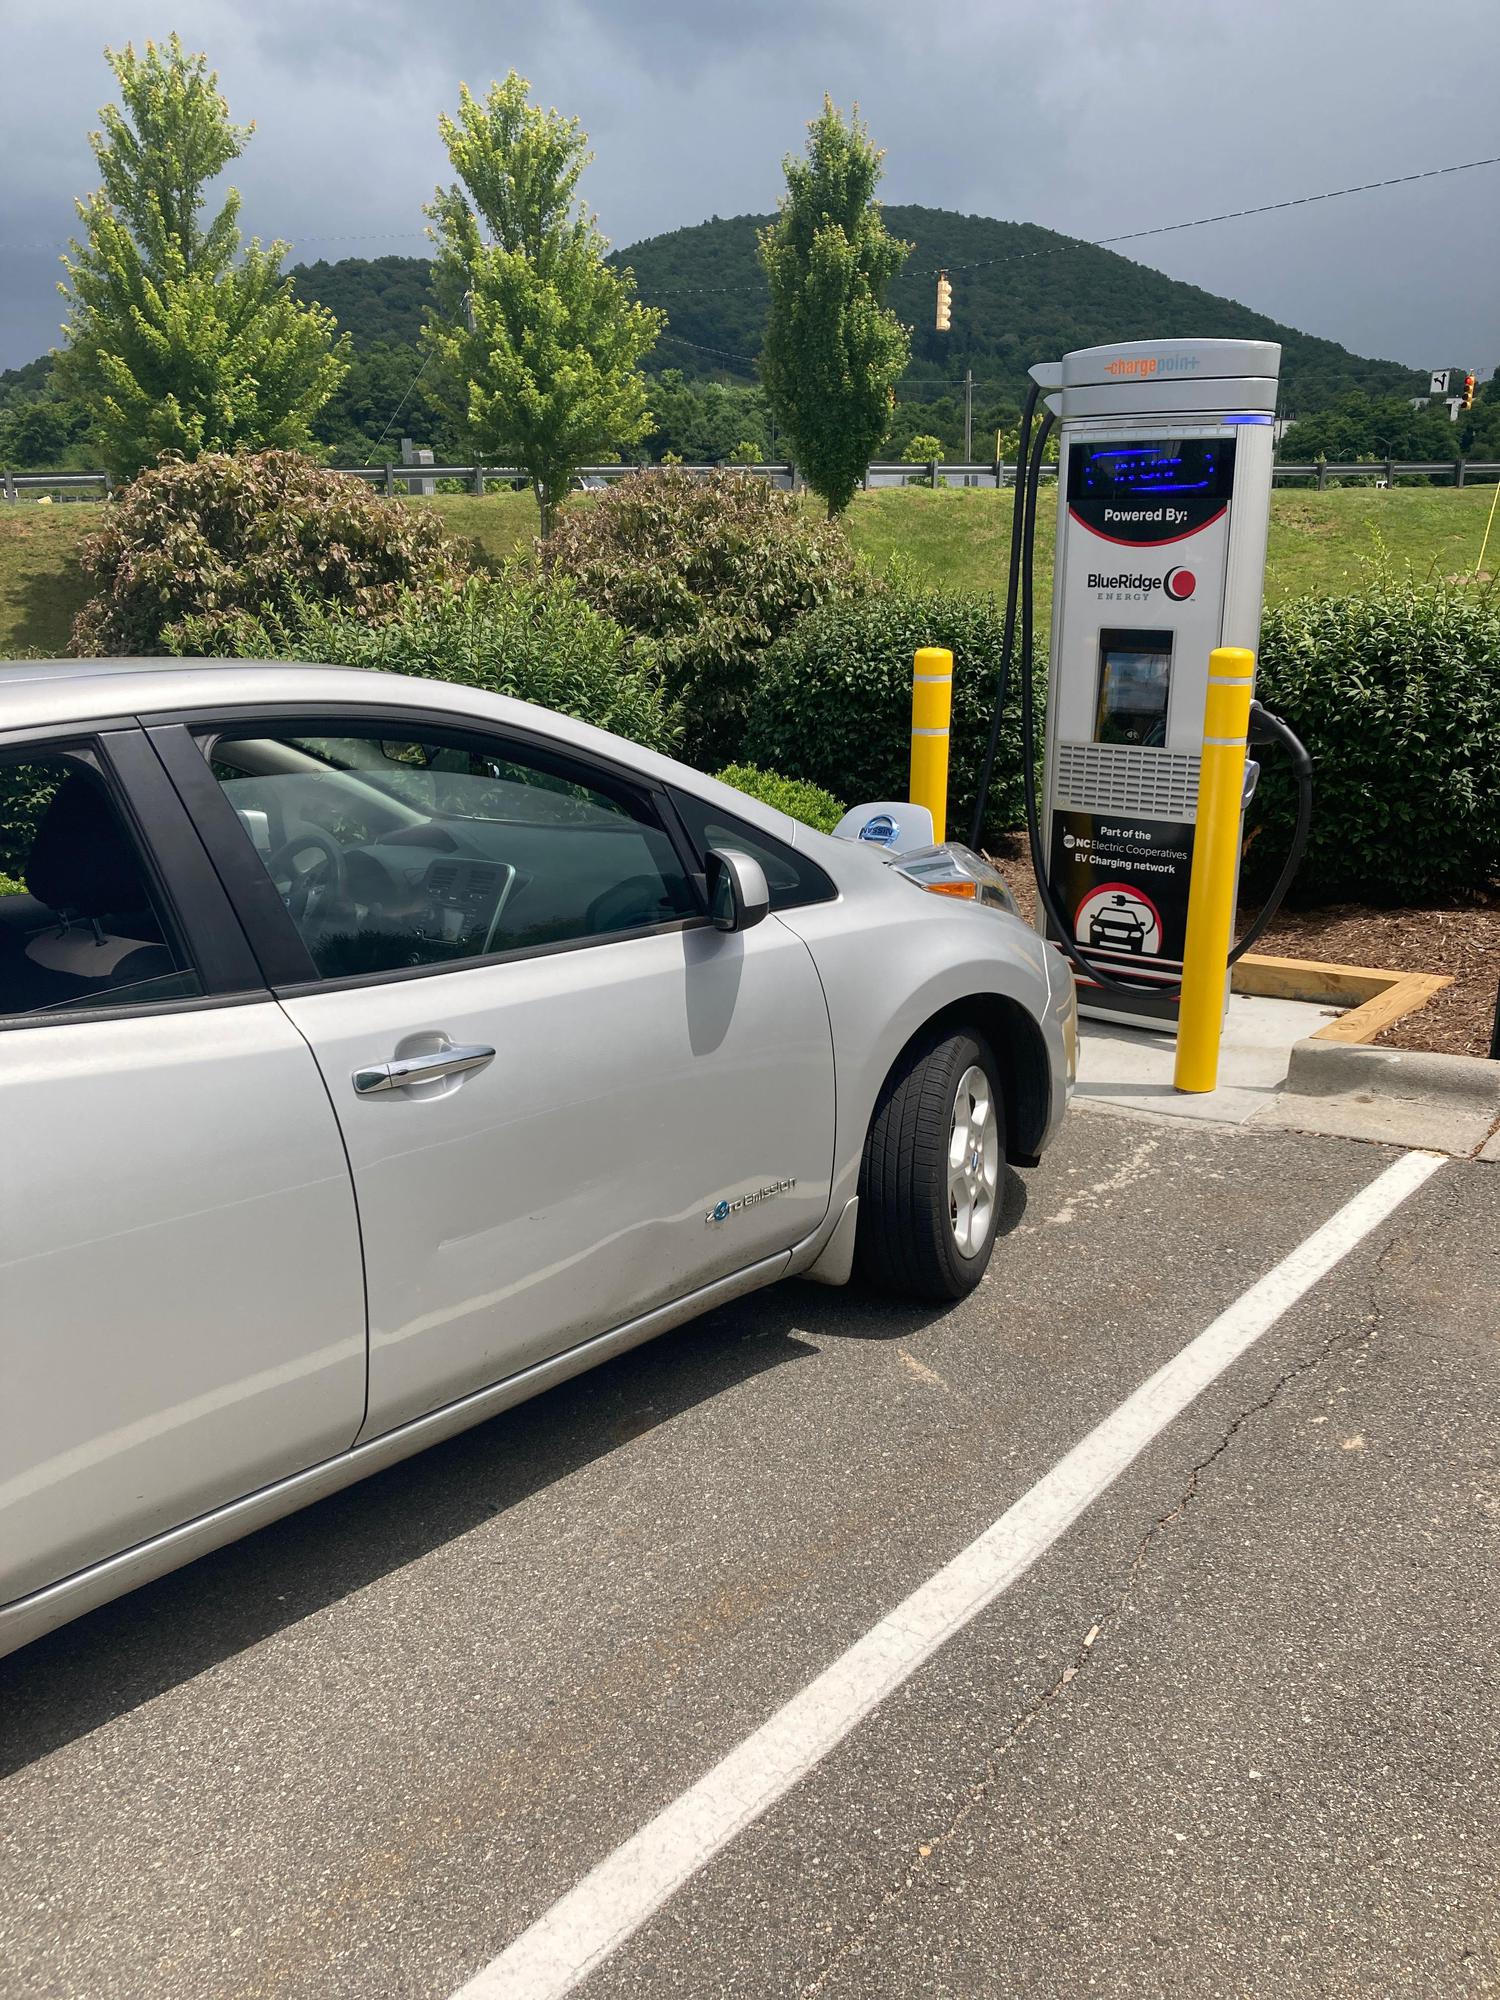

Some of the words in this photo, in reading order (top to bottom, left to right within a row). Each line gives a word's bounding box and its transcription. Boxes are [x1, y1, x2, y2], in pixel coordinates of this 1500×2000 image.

[1104, 508, 1162, 521] Powered
[1166, 508, 1188, 523] By:
[1088, 573, 1162, 591] BlueRidge
[1100, 826, 1120, 837] Part
[1122, 830, 1134, 838] of
[1135, 830, 1152, 840] the
[1076, 838, 1091, 848] NC
[1091, 840, 1125, 853] Electric
[1126, 844, 1188, 860] Cooperatives
[1074, 853, 1088, 862] EV
[1089, 855, 1132, 870] Charging
[1133, 863, 1175, 874] network
